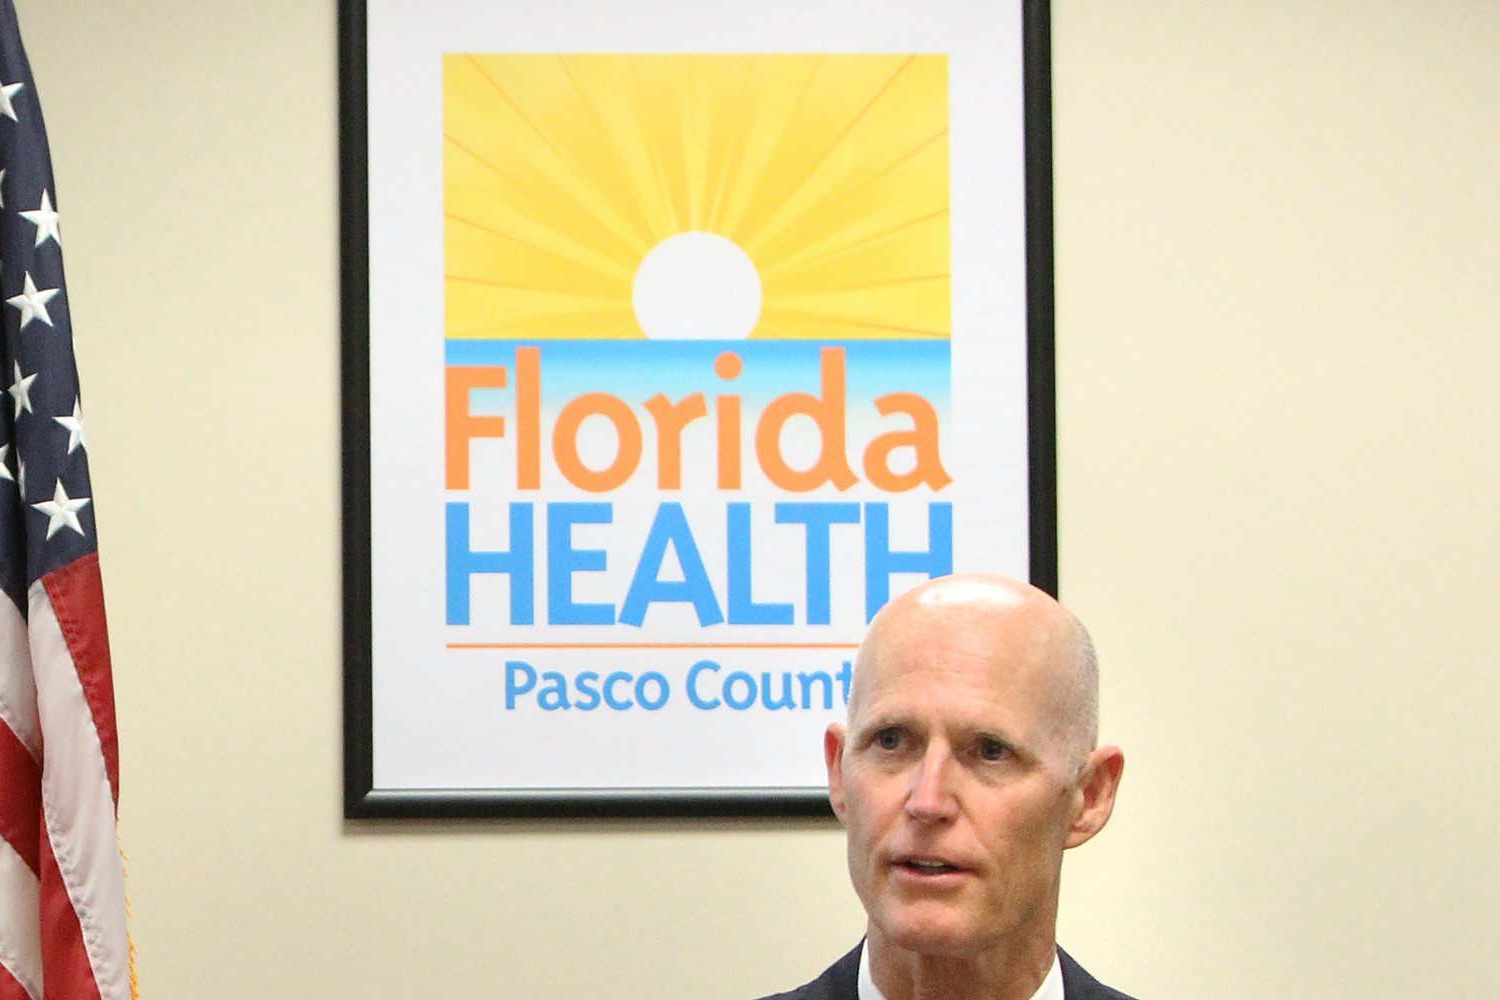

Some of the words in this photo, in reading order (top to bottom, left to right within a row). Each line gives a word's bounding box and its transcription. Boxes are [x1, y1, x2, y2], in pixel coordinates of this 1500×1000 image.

[444, 346, 954, 493] Florida
[445, 501, 953, 628] HEALTH
[504, 660, 670, 711] Pasco
[686, 660, 853, 711] Count
